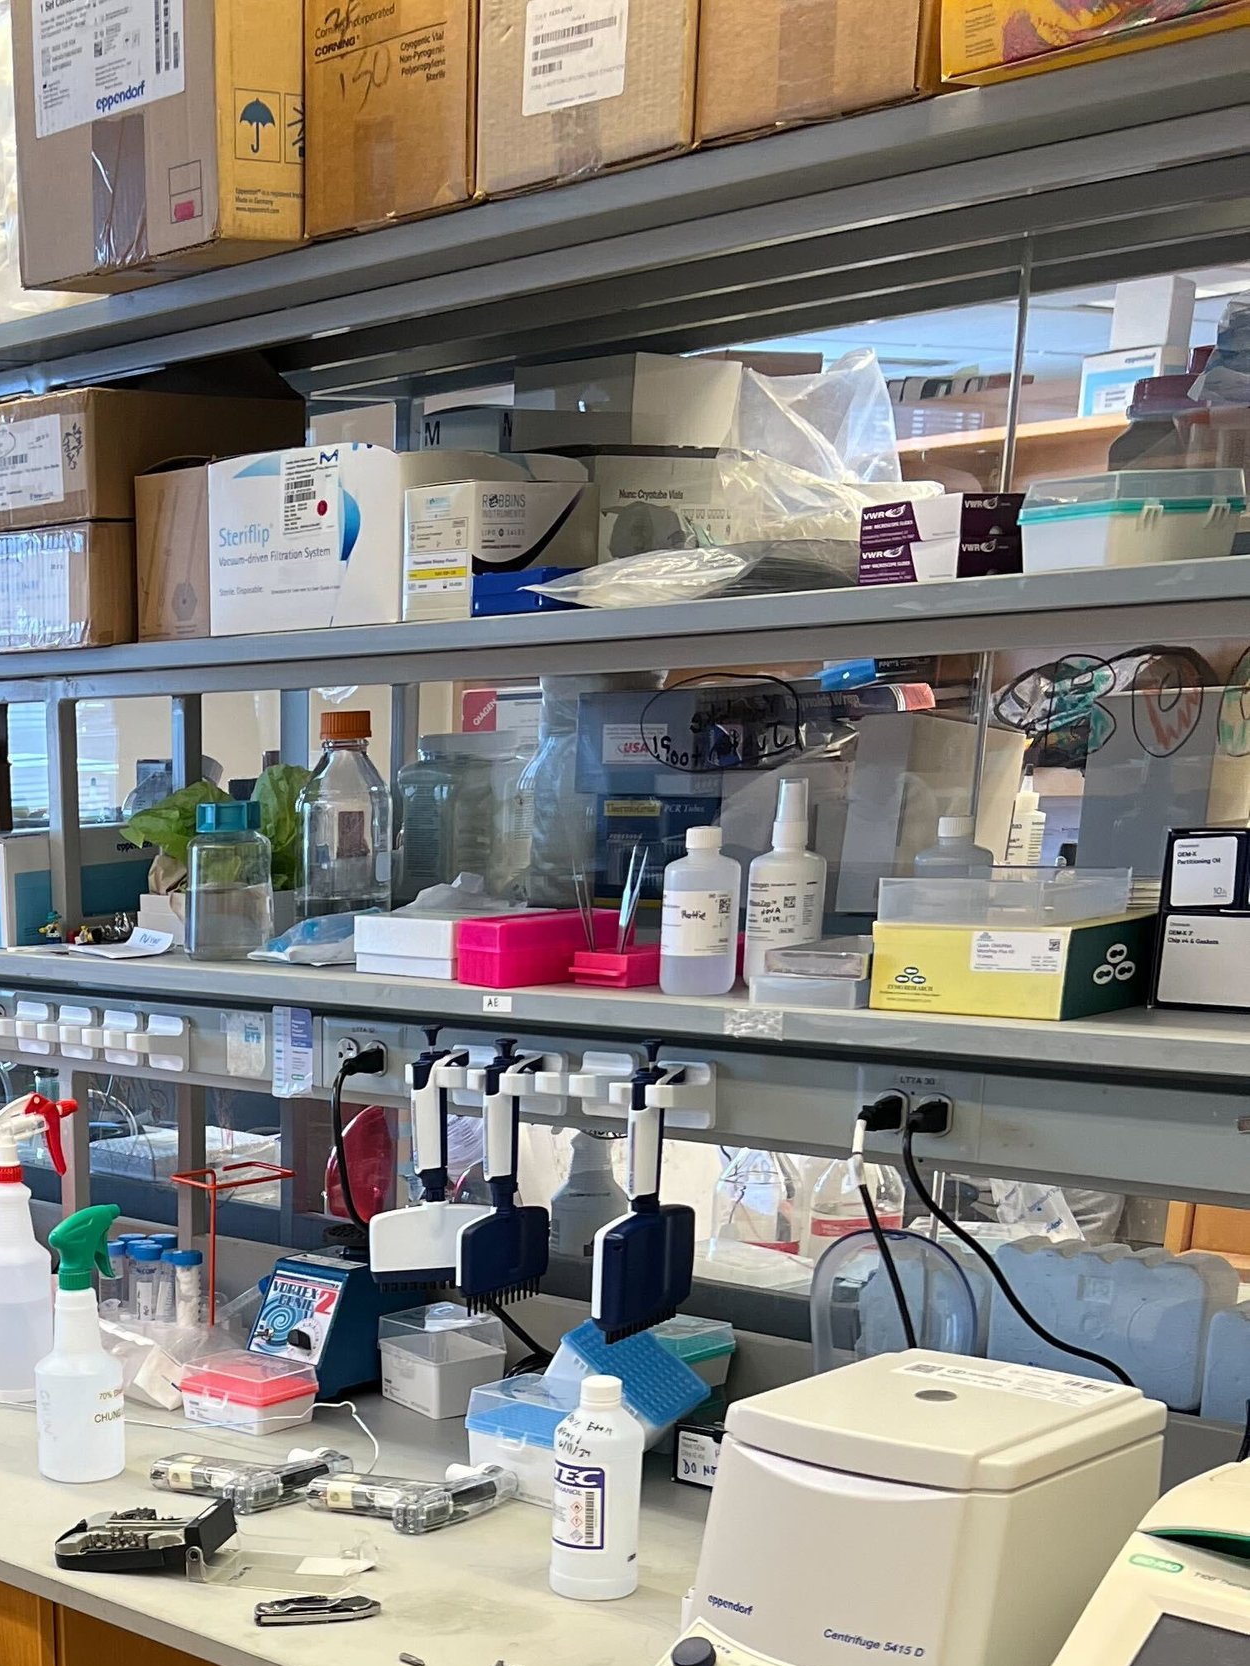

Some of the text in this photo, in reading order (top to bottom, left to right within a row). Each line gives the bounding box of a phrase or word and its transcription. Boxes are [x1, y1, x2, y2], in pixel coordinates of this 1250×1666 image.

[96, 80, 146, 112] eppendorf
[424, 421, 440, 446] M
[965, 499, 983, 509] VWR
[863, 512, 885, 521] VWR
[219, 523, 270, 548] Steriflip
[219, 547, 330, 567] Vacuum-driven Filtration System
[862, 550, 883, 559] VWR
[961, 543, 980, 552] VWR
[473, 697, 497, 727] QIAGEN
[623, 743, 649, 754] USA
[487, 998, 499, 1007] AE
[707, 1594, 753, 1616] eppendorf
[823, 1628, 924, 1657] Centrifuge 5415 D
